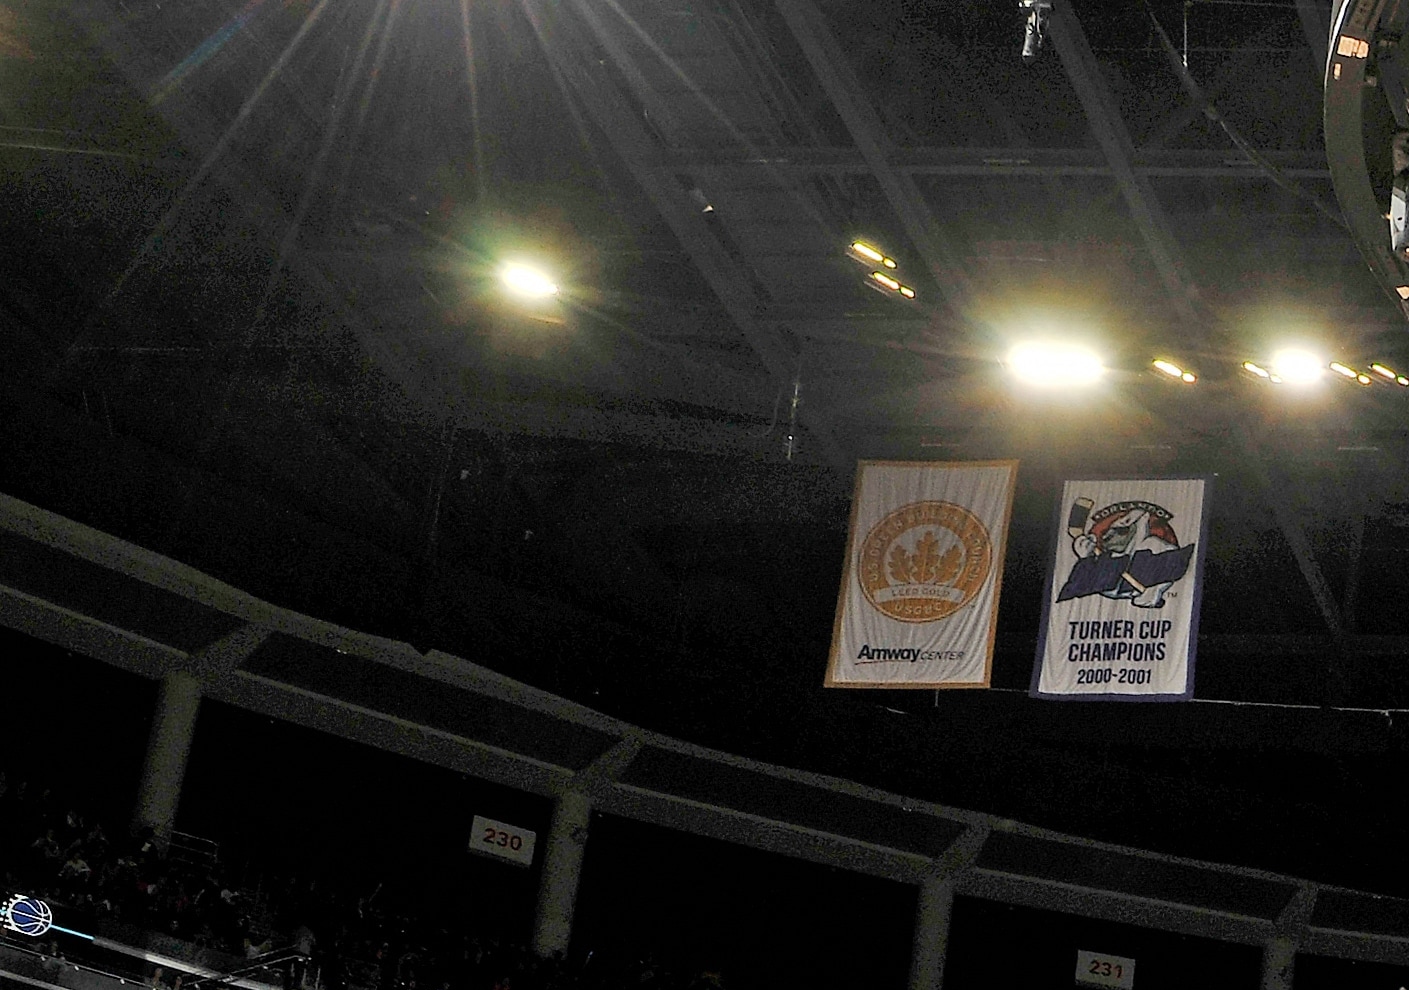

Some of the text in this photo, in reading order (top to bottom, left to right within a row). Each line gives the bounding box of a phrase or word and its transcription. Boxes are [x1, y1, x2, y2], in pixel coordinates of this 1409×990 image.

[1069, 619, 1172, 640] TURNER CUP
[857, 644, 965, 663] Amway CENTER
[1068, 642, 1166, 663] CHAMPIONS
[1077, 668, 1151, 685] 2000-2001
[481, 826, 523, 852] 230
[1087, 959, 1122, 980] 231
